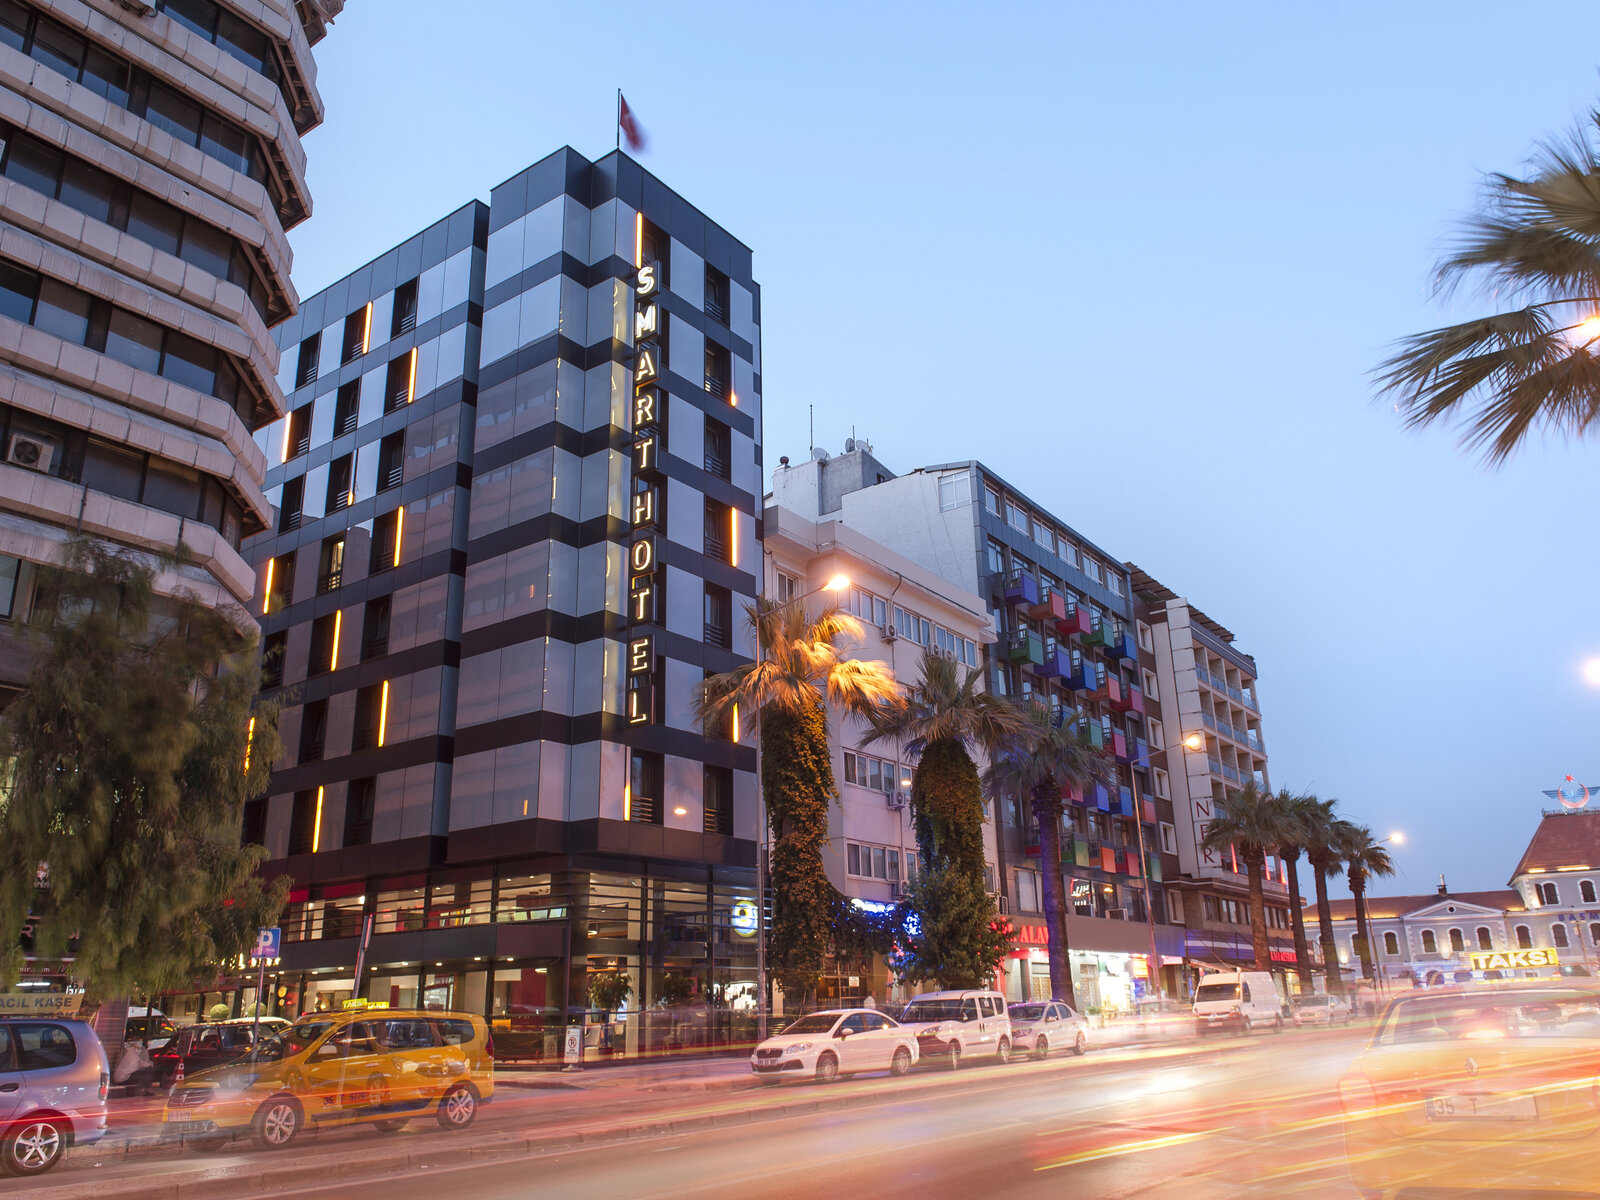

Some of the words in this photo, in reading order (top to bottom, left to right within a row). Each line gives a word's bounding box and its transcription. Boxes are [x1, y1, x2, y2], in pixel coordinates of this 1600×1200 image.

[635, 266, 657, 469] SMART
[629, 491, 653, 725] HOTEL
[1435, 1098, 1455, 1115] 35
